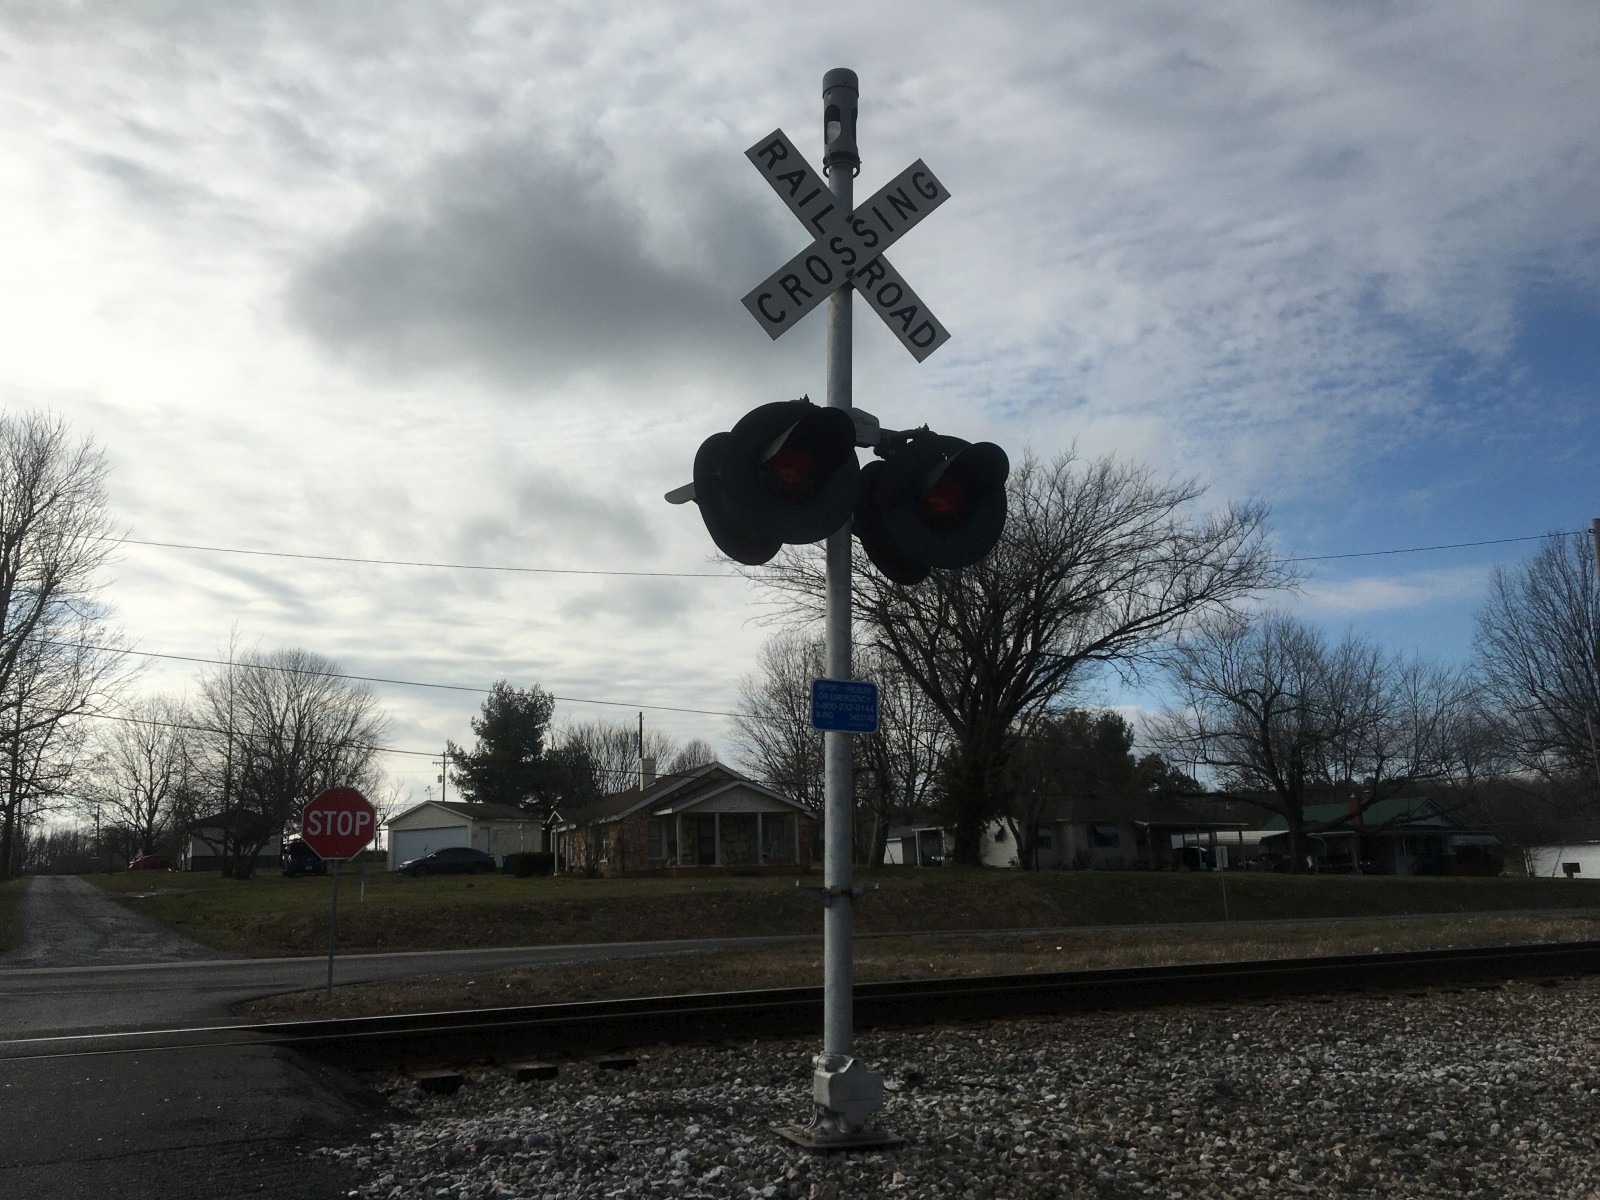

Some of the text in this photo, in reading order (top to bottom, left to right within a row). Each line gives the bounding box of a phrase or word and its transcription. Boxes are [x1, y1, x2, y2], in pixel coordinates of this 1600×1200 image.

[757, 138, 936, 348] RAIL ROAD
[757, 171, 939, 324] CROSSING
[815, 701, 874, 713] 1-800-232-0144
[818, 692, 871, 703] OR EMERGENCY
[306, 810, 371, 836] STOP
